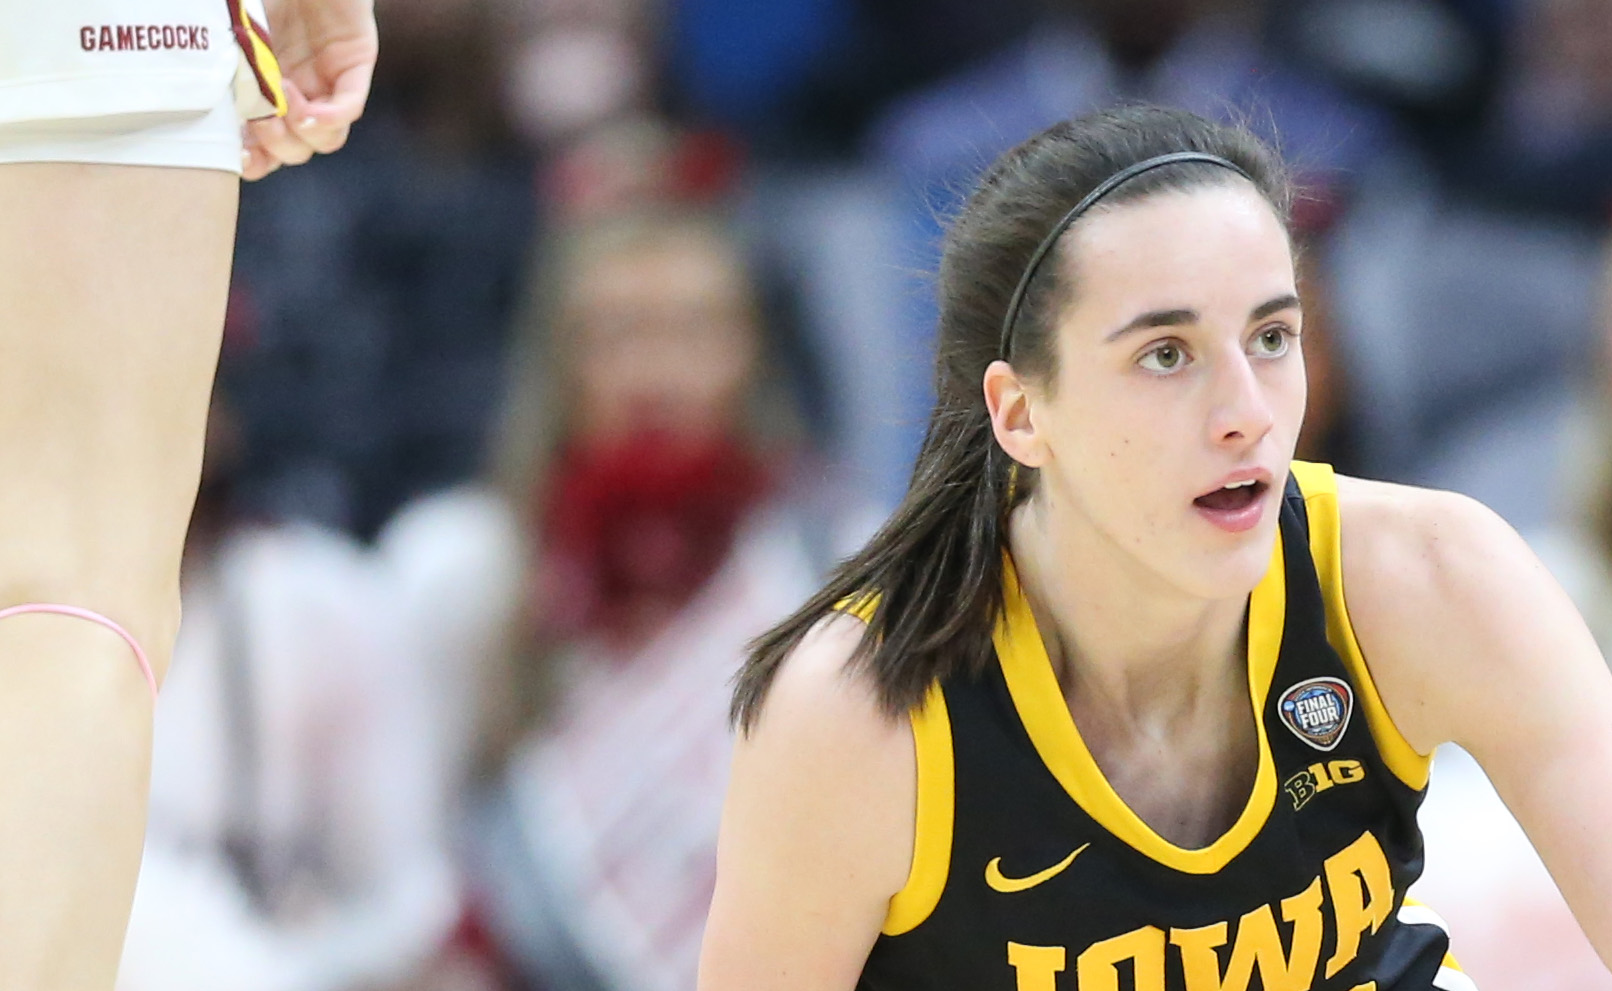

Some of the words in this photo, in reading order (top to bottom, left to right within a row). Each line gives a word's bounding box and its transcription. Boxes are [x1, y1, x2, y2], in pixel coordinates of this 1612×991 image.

[80, 25, 209, 51] GAMECOCKS
[1296, 693, 1335, 715] FINAL
[1300, 706, 1340, 729] FOUR
